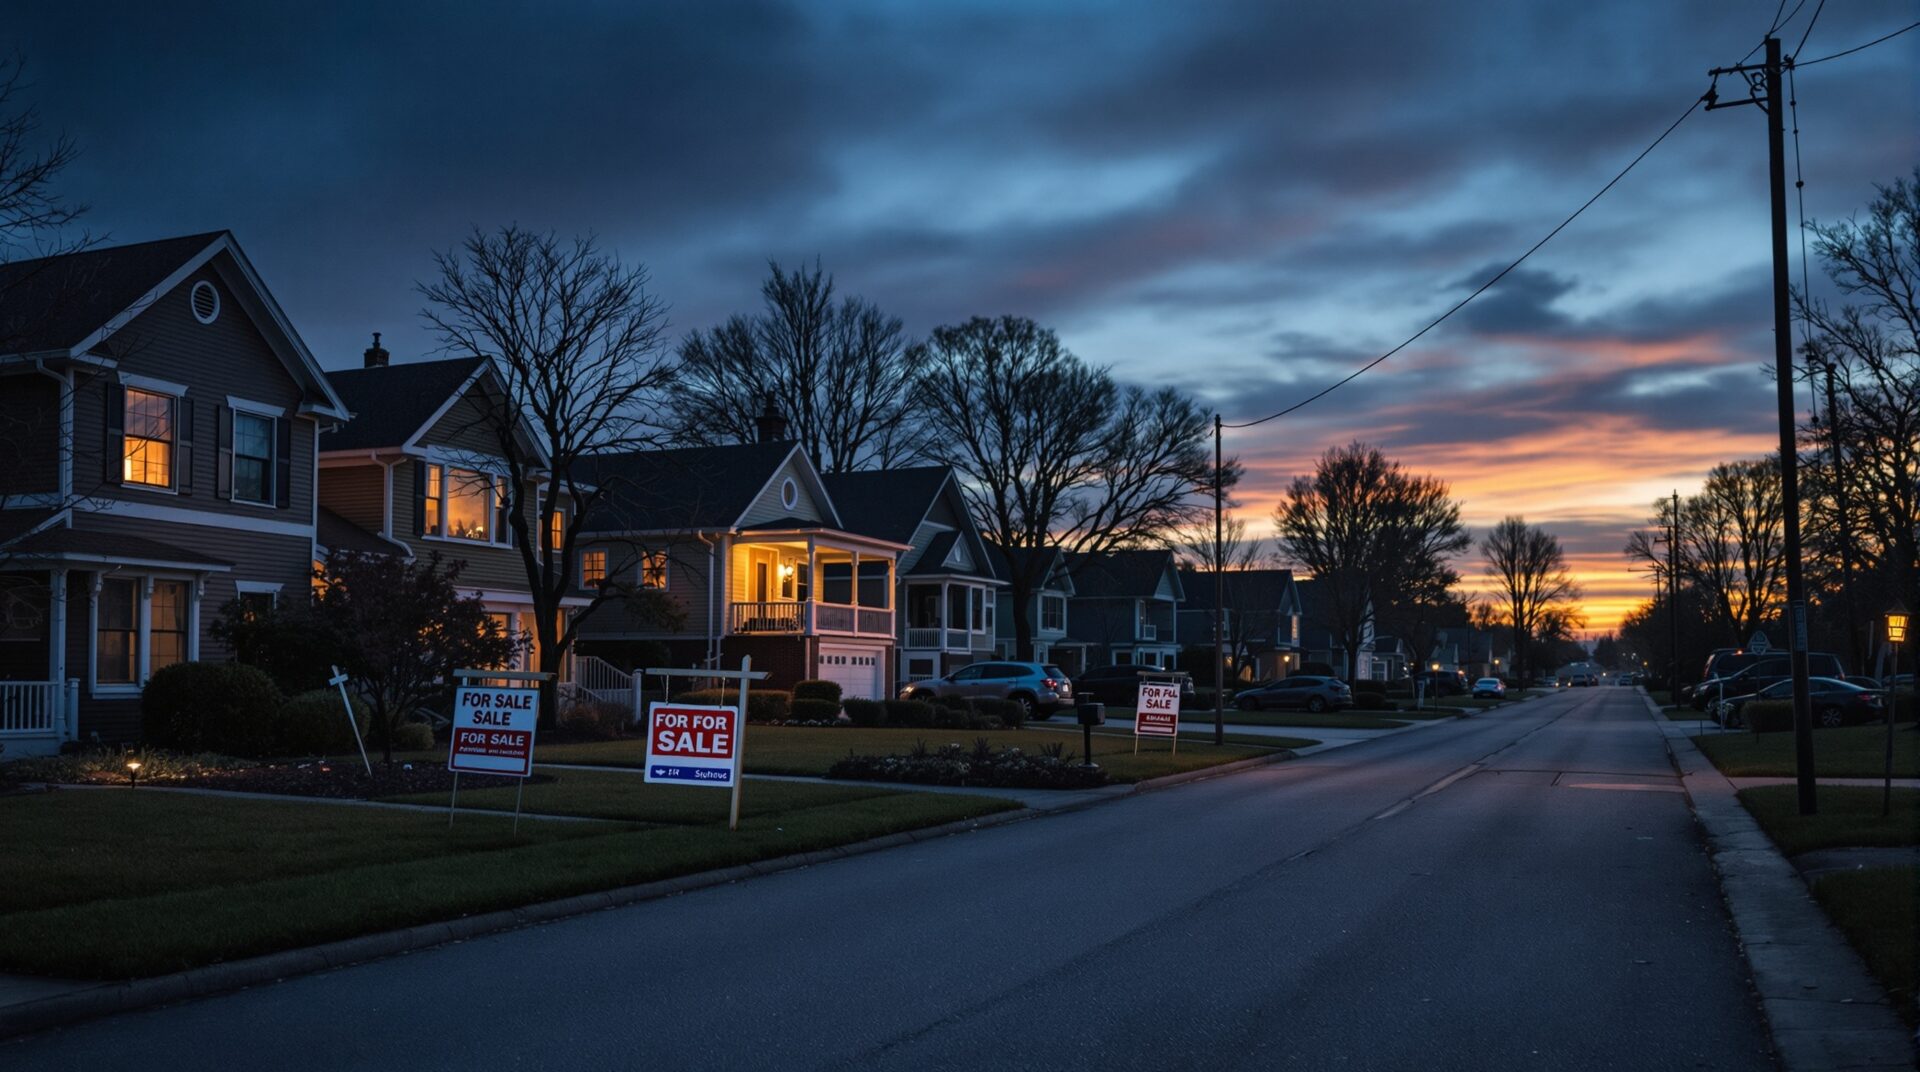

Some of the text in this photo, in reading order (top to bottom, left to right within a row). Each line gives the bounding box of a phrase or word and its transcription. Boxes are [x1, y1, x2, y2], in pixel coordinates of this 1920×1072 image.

[1142, 687, 1160, 697] FOR
[462, 692, 533, 709] FOR SALE
[1146, 698, 1171, 709] SALE
[472, 710, 512, 726] SALE
[656, 714, 727, 729] FOR FOR
[460, 732, 525, 746] FOR SALE
[657, 730, 729, 754] SALE
